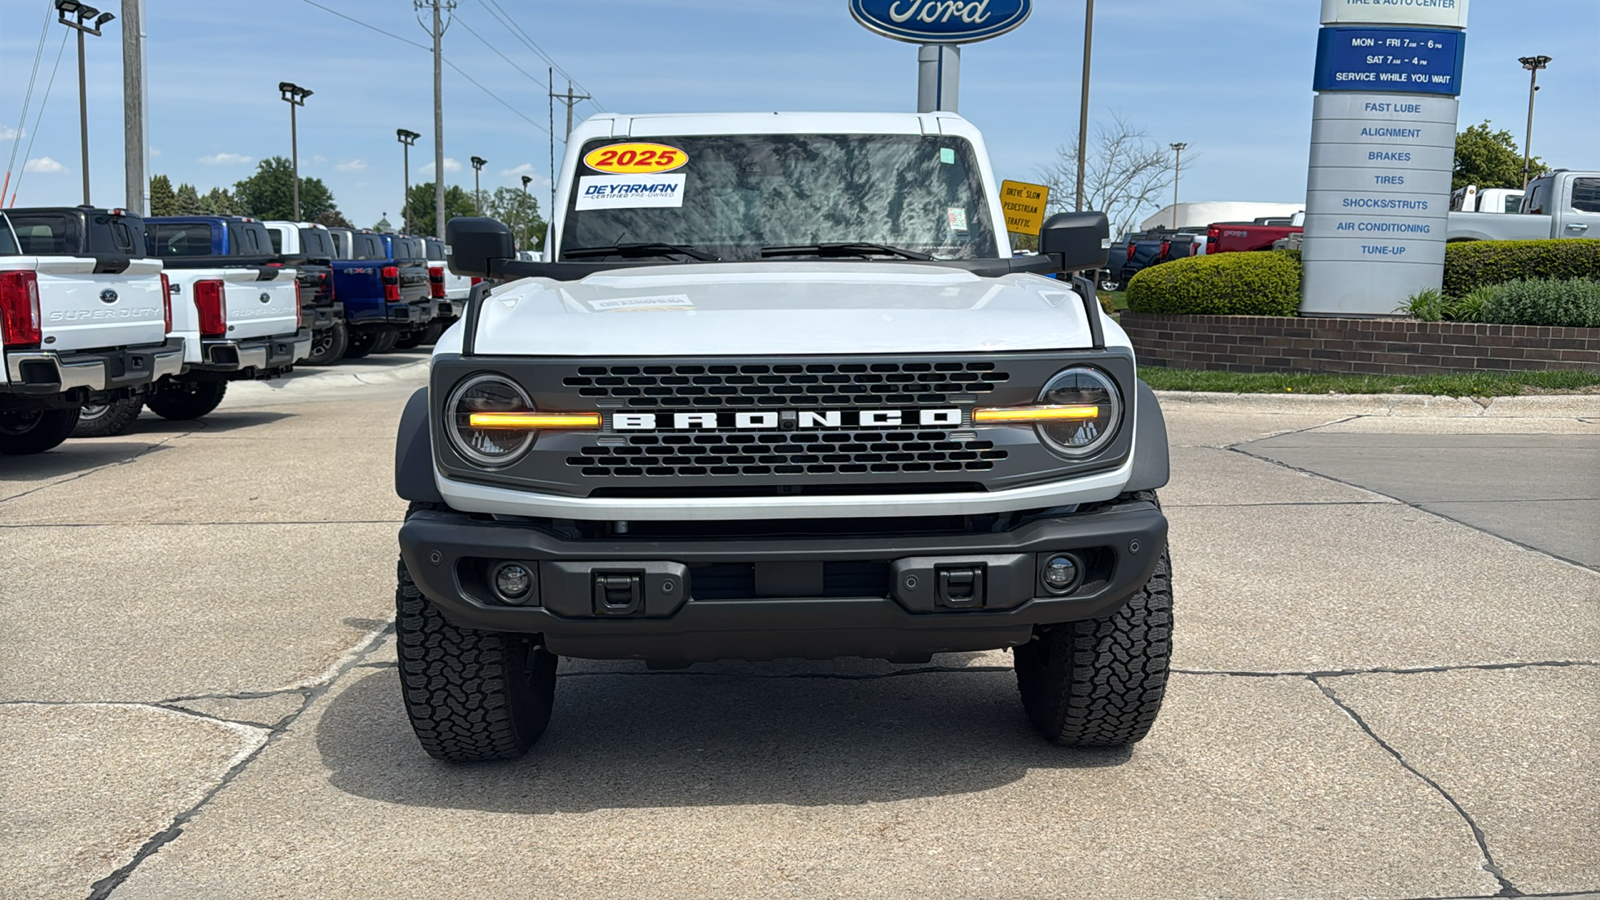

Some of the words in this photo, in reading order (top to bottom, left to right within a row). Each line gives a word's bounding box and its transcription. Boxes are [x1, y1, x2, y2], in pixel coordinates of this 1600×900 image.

[1416, 0, 1455, 9] CENTER
[889, 0, 991, 23] Ford
[1352, 38, 1375, 47] MON
[1386, 39, 1401, 47] FRI
[1366, 56, 1384, 64] SAT
[1335, 73, 1376, 81] SERVICE
[1379, 73, 1408, 82] WHILE
[1411, 74, 1429, 83] YOU
[1431, 75, 1451, 84] WAIT
[1365, 103, 1392, 112] FAST
[1394, 104, 1421, 113] LUBE
[1360, 128, 1421, 138] ALIGNMENT
[594, 150, 678, 166] 2025
[1368, 152, 1411, 161] BRAKES
[1374, 176, 1404, 185] TIRES
[585, 183, 678, 195] DEYARMAN
[1006, 187, 1023, 197] DRIVE
[1026, 190, 1041, 200] SLOW
[1004, 202, 1038, 213] PEDESTRIAN
[1342, 198, 1428, 210] SHOCKS/STRUTS
[1007, 217, 1030, 227] TRAFFIC
[1336, 222, 1355, 231] AIR
[1357, 222, 1430, 234] CONDITIONING
[1361, 245, 1406, 255] TUNE-UP
[49, 309, 116, 322] SUPER
[119, 307, 160, 319] DUTY
[612, 408, 962, 430] BRONCO
